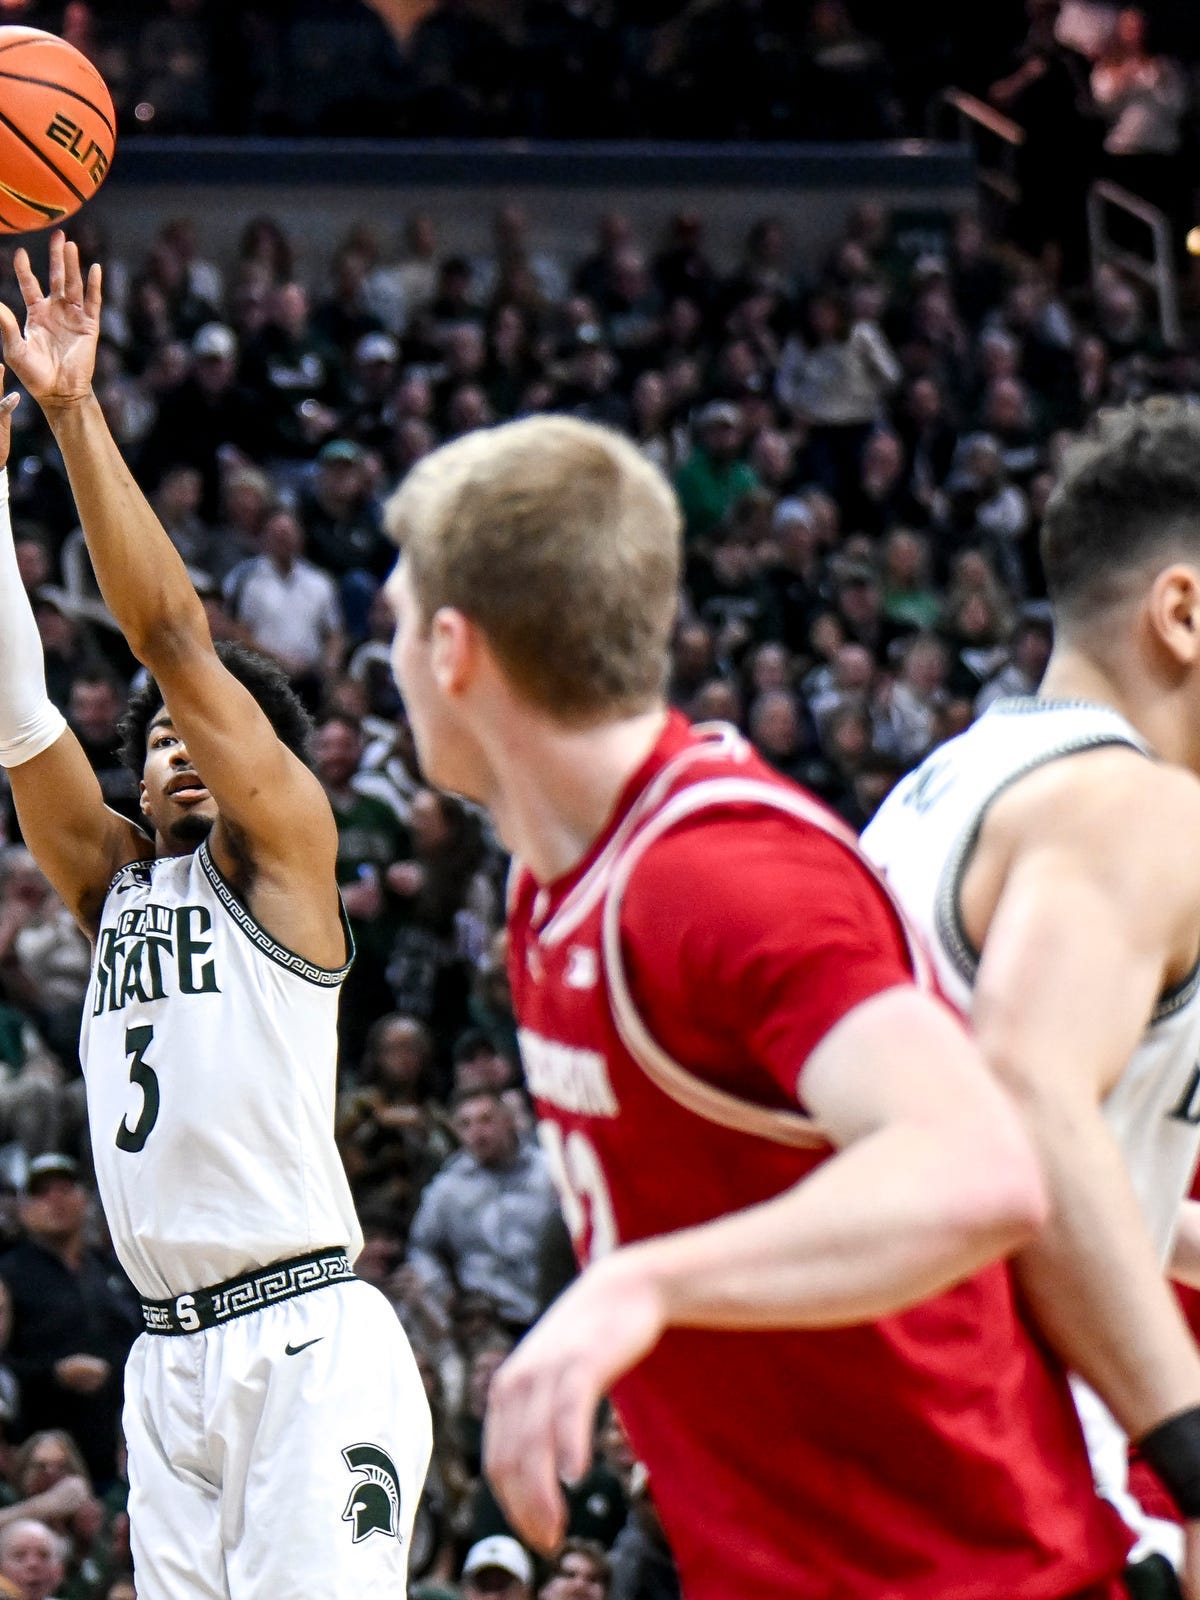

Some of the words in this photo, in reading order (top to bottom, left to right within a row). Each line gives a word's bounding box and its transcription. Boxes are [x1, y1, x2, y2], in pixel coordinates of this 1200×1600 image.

[45, 112, 108, 185] ELITE
[93, 905, 222, 1018] STATE
[116, 1024, 160, 1153] 3
[176, 1294, 200, 1331] S
